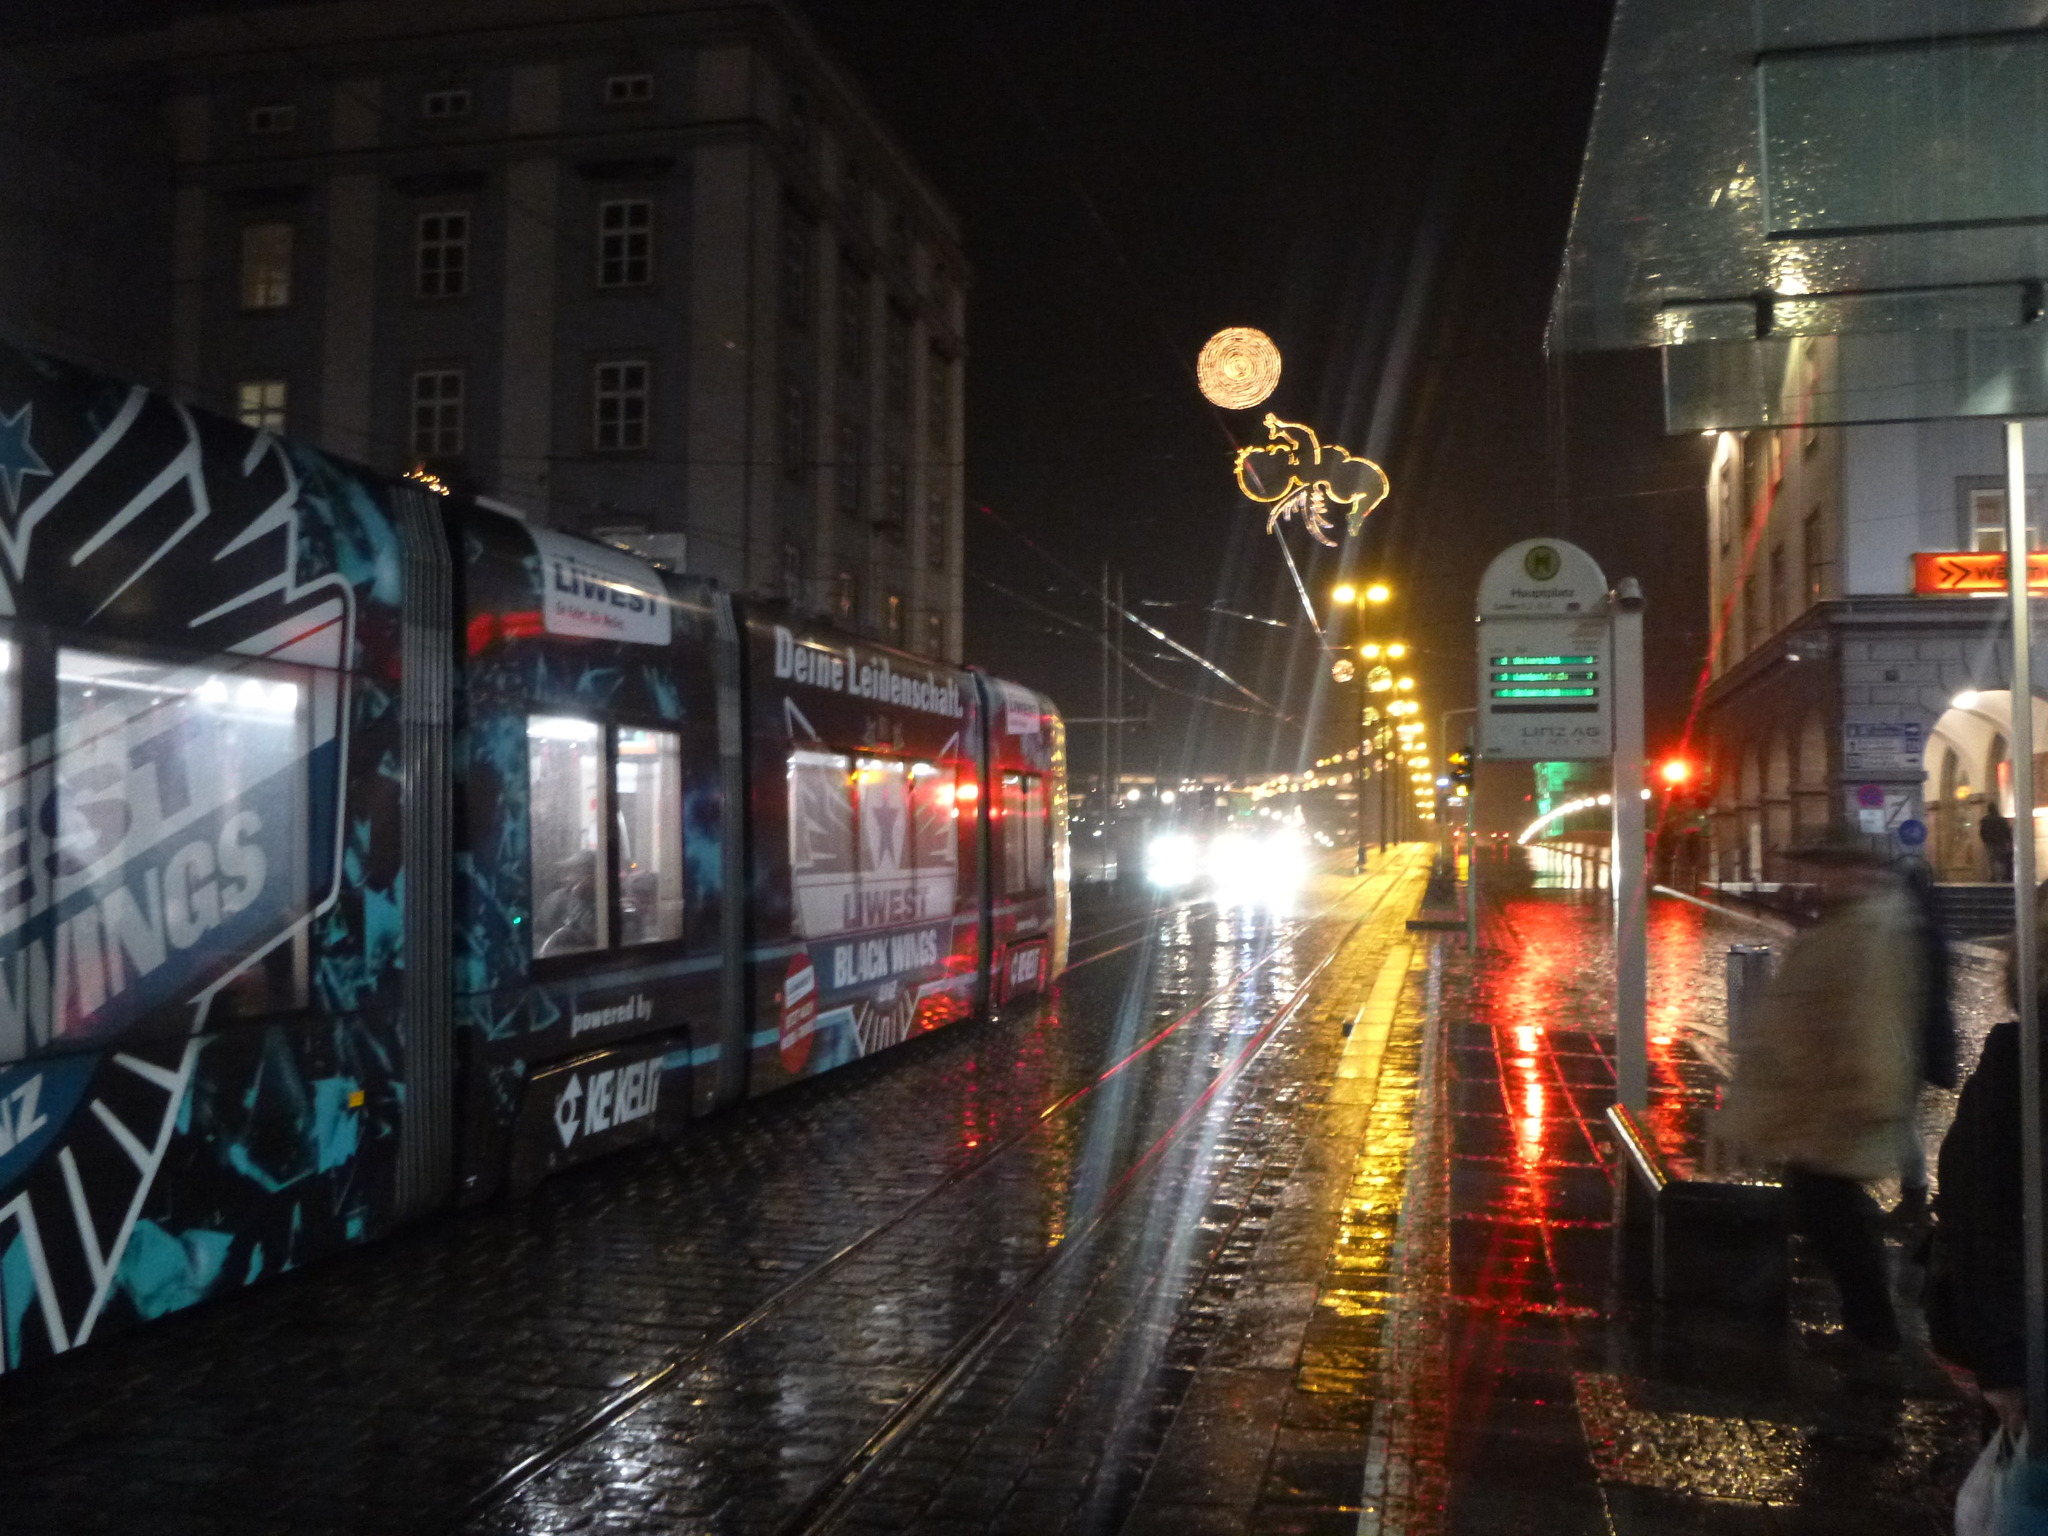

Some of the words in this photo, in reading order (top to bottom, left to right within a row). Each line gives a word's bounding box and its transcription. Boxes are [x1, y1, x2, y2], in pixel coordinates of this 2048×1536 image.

[774, 624, 844, 692] Deine
[843, 885, 929, 930] LIWEST
[833, 938, 889, 989] BLACK
[890, 928, 938, 976] WINGS
[570, 994, 635, 1039] powered
